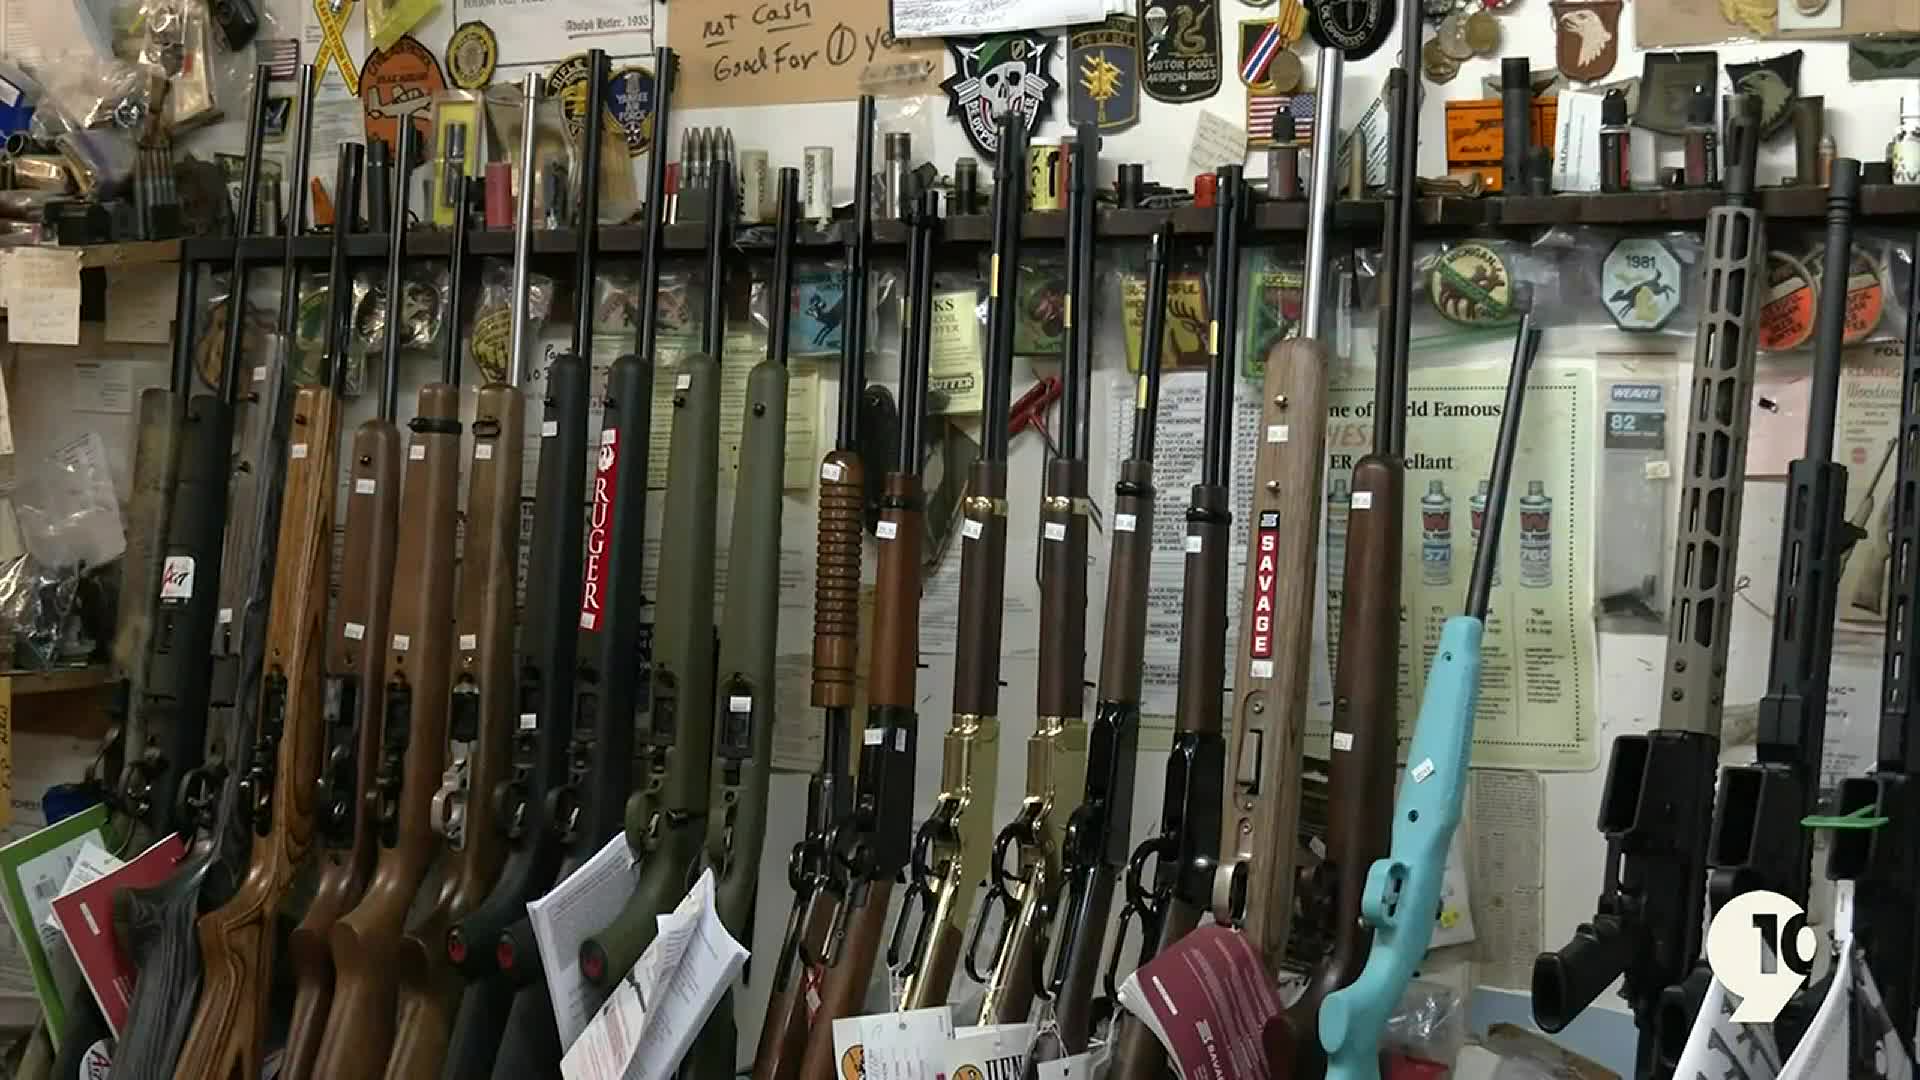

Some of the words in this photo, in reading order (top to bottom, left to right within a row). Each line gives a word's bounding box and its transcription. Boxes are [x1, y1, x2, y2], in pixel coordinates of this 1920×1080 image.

[714, 47, 767, 81] Good
[1187, 58, 1216, 70] POOL
[1626, 255, 1656, 269] 1981
[1355, 400, 1374, 417] of
[1434, 401, 1501, 418] Famous
[1611, 414, 1636, 430] 82
[1404, 453, 1453, 471] ellant
[582, 477, 609, 609] RUGER
[1255, 535, 1275, 652] SAVAGE
